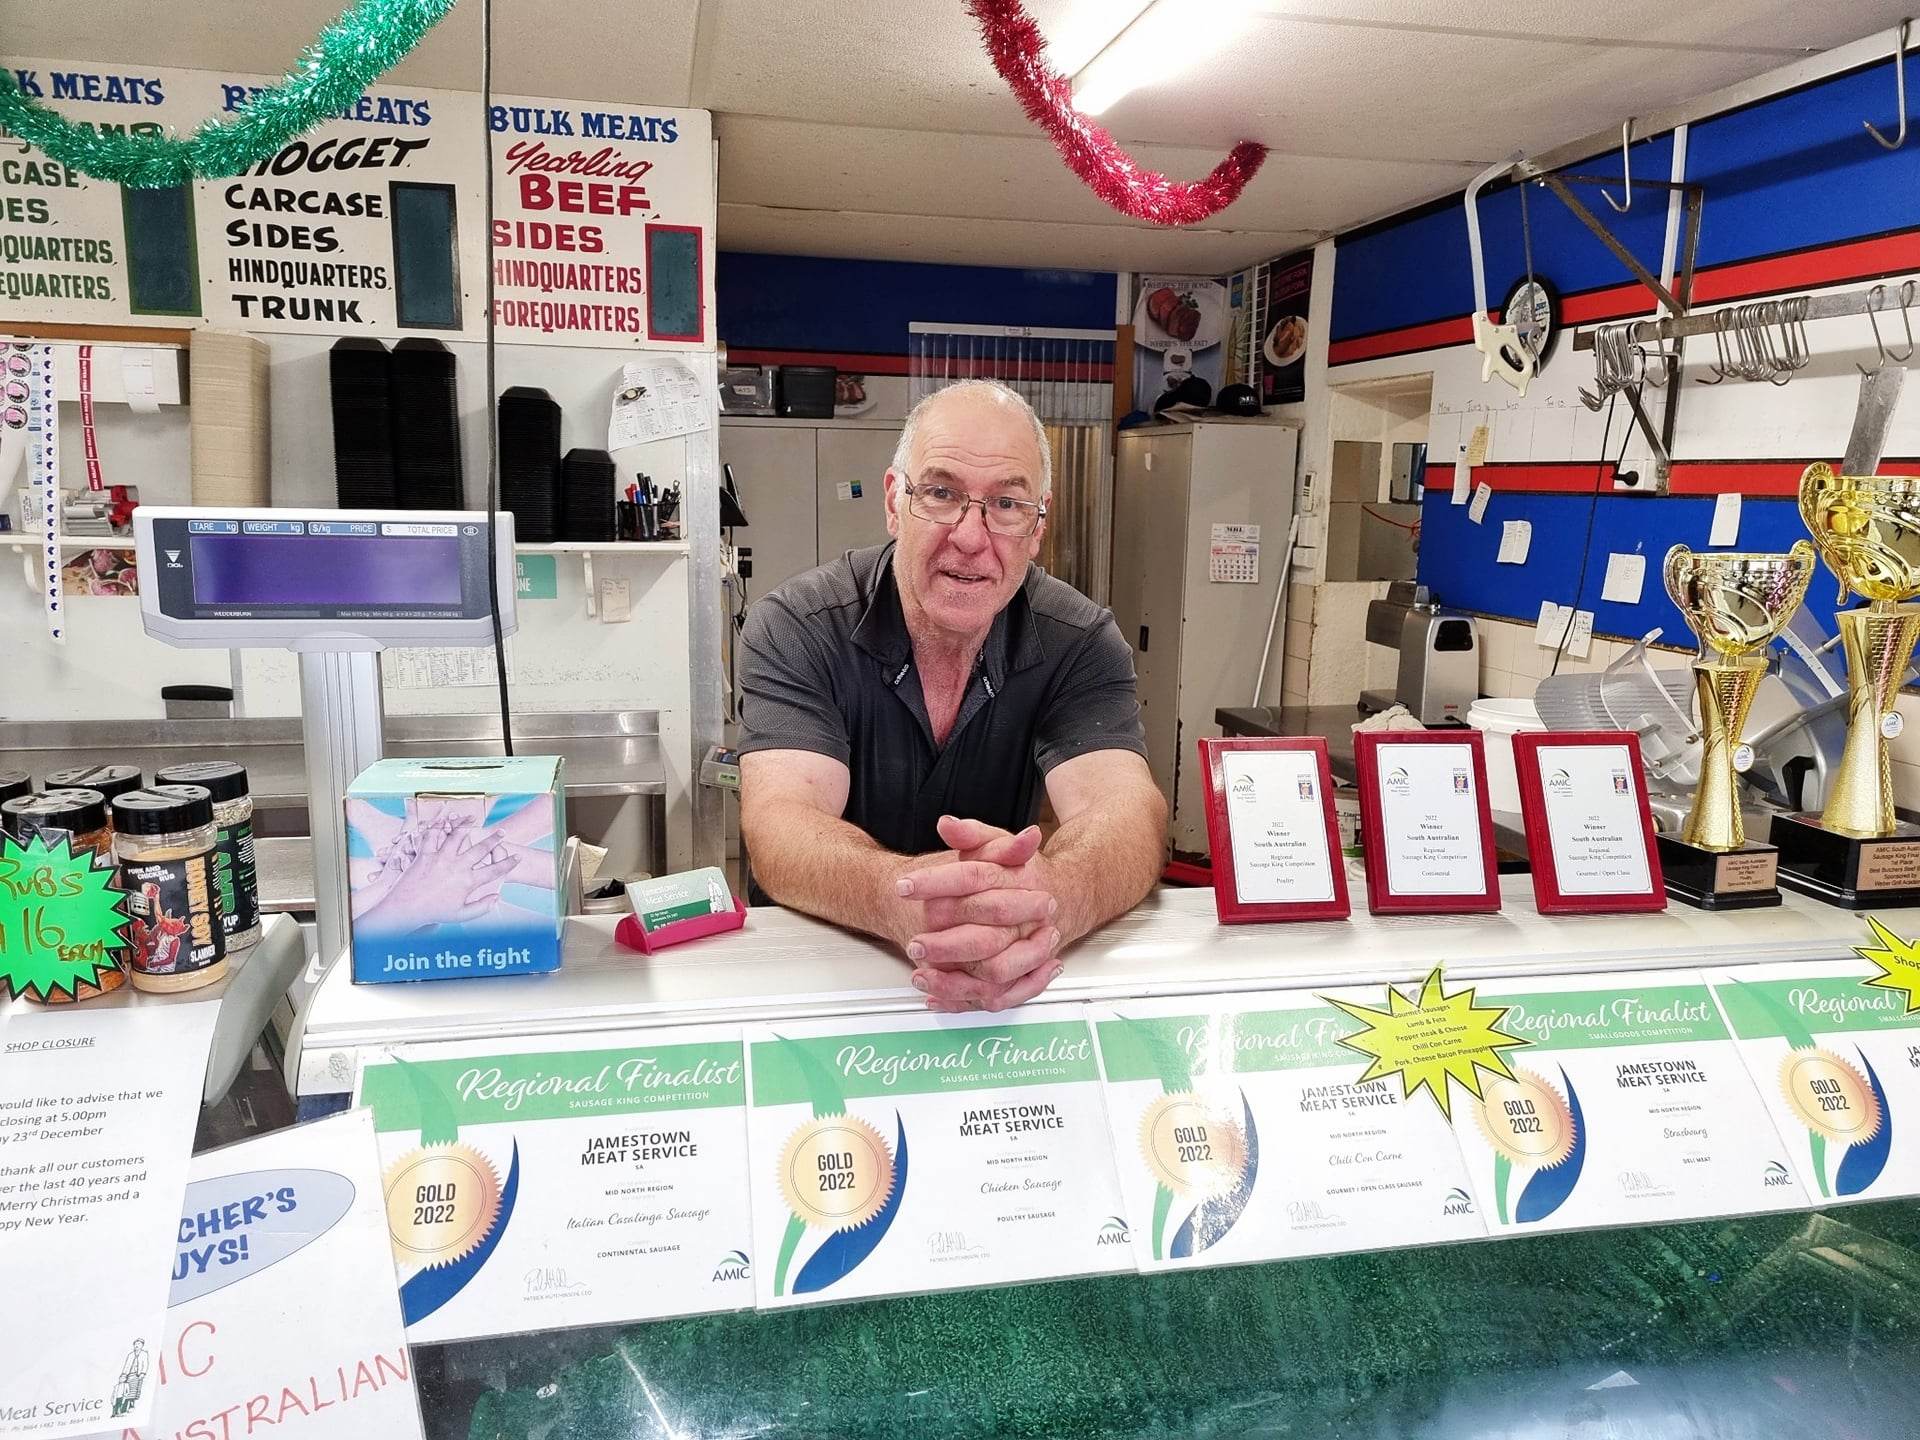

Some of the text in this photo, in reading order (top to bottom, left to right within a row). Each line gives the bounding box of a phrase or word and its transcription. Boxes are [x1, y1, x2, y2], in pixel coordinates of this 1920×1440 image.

[51, 72, 165, 106] MEATS
[344, 96, 433, 127] EATS
[489, 105, 680, 143] BULK MEATS
[506, 141, 653, 185] Yearling
[0, 159, 89, 191] CASE,
[0, 235, 118, 267] QUARTERS,
[194, 522, 215, 531] TARE
[226, 522, 237, 532] kg
[247, 523, 278, 532] WEIGHT
[290, 523, 301, 533] kg
[350, 524, 373, 533] PRICE
[407, 526, 430, 534] TOTAL
[432, 526, 453, 535] PRICE
[1274, 840, 1307, 848] Australian
[383, 947, 532, 972] Join the fight
[1422, 1003, 1451, 1014] Sausages
[1787, 988, 1898, 1024] Regional
[1501, 997, 1712, 1042] Regional Finalist
[1641, 1027, 1693, 1038] COMPETITION
[5, 1036, 97, 1053] SHOP CLOSURE
[1429, 1040, 1442, 1049] Con
[836, 1035, 1092, 1085] Regional Finalist
[1437, 1050, 1457, 1060] Bacon
[940, 1067, 1067, 1083] SAUSAGE KING COMPETITION
[1616, 1059, 1697, 1076] JAMESTOWN
[455, 1057, 741, 1111] Regional Finalist
[1616, 1070, 1708, 1088] MEAT SERVICE
[1808, 1077, 1841, 1096] GOLD
[36, 1097, 57, 1108] like
[60, 1096, 74, 1106] to
[76, 1092, 115, 1104] advise
[118, 1090, 142, 1101] that
[145, 1089, 163, 1098] we
[569, 1091, 710, 1109] SAUSAGE KING COMPETITION
[1301, 1080, 1388, 1102] JAMESTOWN
[1299, 1092, 1398, 1113] MEAT SERVICE
[1503, 1099, 1536, 1118] GOLD
[1817, 1094, 1850, 1111] 2022
[0, 1110, 107, 1127] closing at 5.00pm
[963, 1103, 1056, 1125] JAMESTOWN
[40, 1126, 104, 1140] December
[959, 1117, 1064, 1137] MEAT SERVICE
[1508, 1116, 1544, 1134] 2022
[1663, 1126, 1708, 1140] Strasbourg
[587, 1130, 691, 1152] JAMESTOWN
[1174, 1126, 1208, 1144] GOLD
[581, 1144, 699, 1165] MEAT SERVICE
[817, 1152, 853, 1172] GOLD
[986, 1153, 1049, 1166] MID NORTH REGION
[1177, 1144, 1213, 1163] 2022
[1354, 1152, 1374, 1164] Con
[1375, 1150, 1403, 1162] Carne
[0, 1155, 145, 1176] thank all our customers
[19, 1181, 40, 1192] the
[43, 1179, 65, 1190] last
[69, 1176, 85, 1187] 40
[88, 1173, 121, 1187] years
[123, 1170, 147, 1182] and
[605, 1184, 674, 1196] MID NORTH REGION
[818, 1171, 856, 1192] 2022
[979, 1177, 1063, 1195] Chicken Sausage
[1763, 1173, 1793, 1188] AMIC
[0, 1189, 140, 1211] Merry Christmas and a
[415, 1182, 456, 1204] GOLD
[413, 1204, 455, 1226] 2022
[996, 1210, 1056, 1223] POULTRY SAUSAGE
[1443, 1202, 1475, 1215] AMIC
[25, 1216, 54, 1228] New
[57, 1212, 89, 1226] Year.
[566, 1206, 712, 1231] Italian Casalinga Sausage
[1096, 1231, 1132, 1247] AMIC
[596, 1244, 682, 1259] CONTINENTAL SAUSAGE
[711, 1265, 751, 1283] AMIC
[44, 1397, 104, 1417] Service
